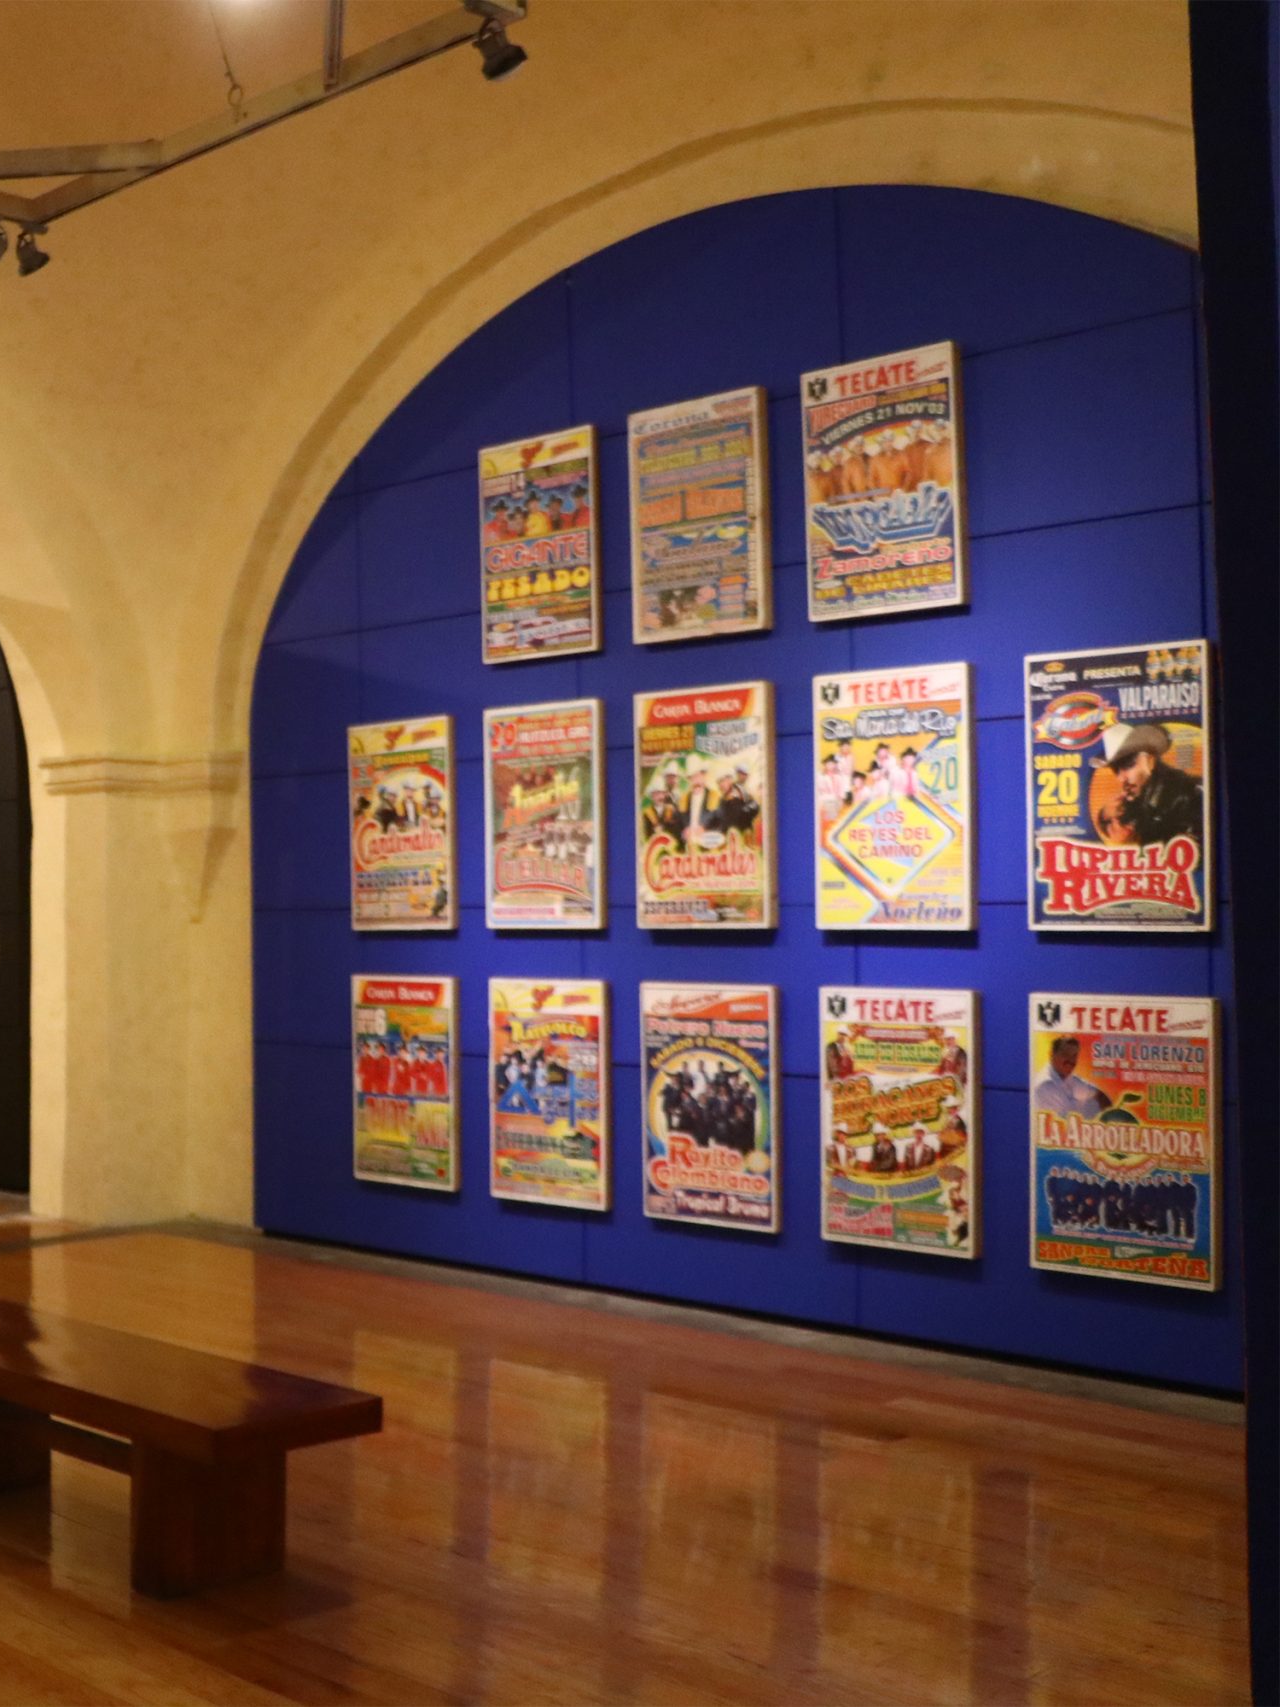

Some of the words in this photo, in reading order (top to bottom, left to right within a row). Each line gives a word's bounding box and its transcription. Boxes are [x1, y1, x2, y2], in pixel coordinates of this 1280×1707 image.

[835, 359, 918, 397] TECATE
[847, 677, 930, 705] TECATE
[1036, 769, 1080, 805] 20
[848, 827, 898, 842] REYES
[902, 826, 933, 841] DEL
[858, 843, 924, 859] CAMINO
[1036, 837, 1199, 879] LUPILLO
[1043, 871, 1199, 913] RIVERA
[853, 998, 936, 1024] TECATE
[1070, 1006, 1169, 1033] TECATE
[1092, 1043, 1126, 1060] SAN
[1131, 1044, 1205, 1064] LORENZO
[1147, 1084, 1193, 1106] LUNES
[1038, 1112, 1064, 1145] LA
[1065, 1113, 1206, 1159] ARROLLADORA
